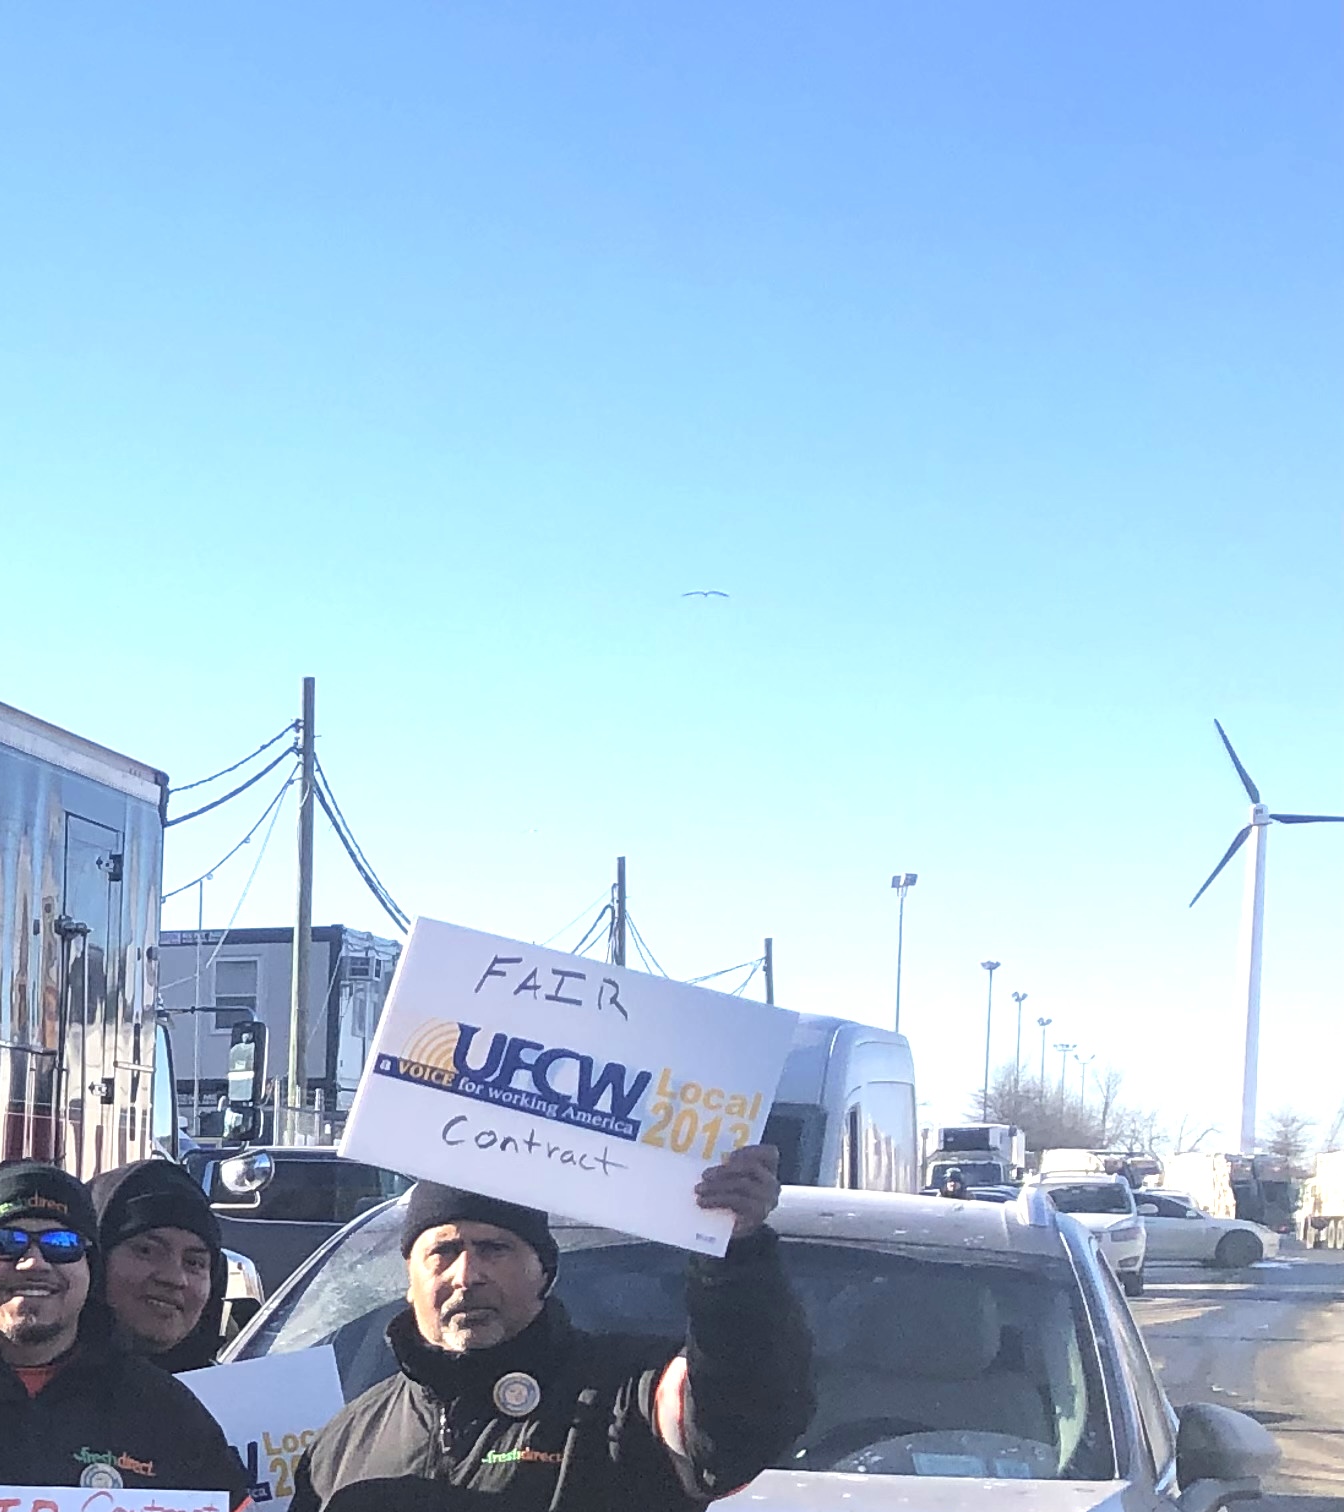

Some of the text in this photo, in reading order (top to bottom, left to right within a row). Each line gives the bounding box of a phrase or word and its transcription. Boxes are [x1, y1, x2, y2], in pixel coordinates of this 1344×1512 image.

[475, 955, 628, 1021] FAIR
[379, 1060, 634, 1135] a VOICE for working America
[453, 1021, 653, 1117] UFCW
[656, 1067, 762, 1121] Local
[442, 1115, 629, 1176] Contract
